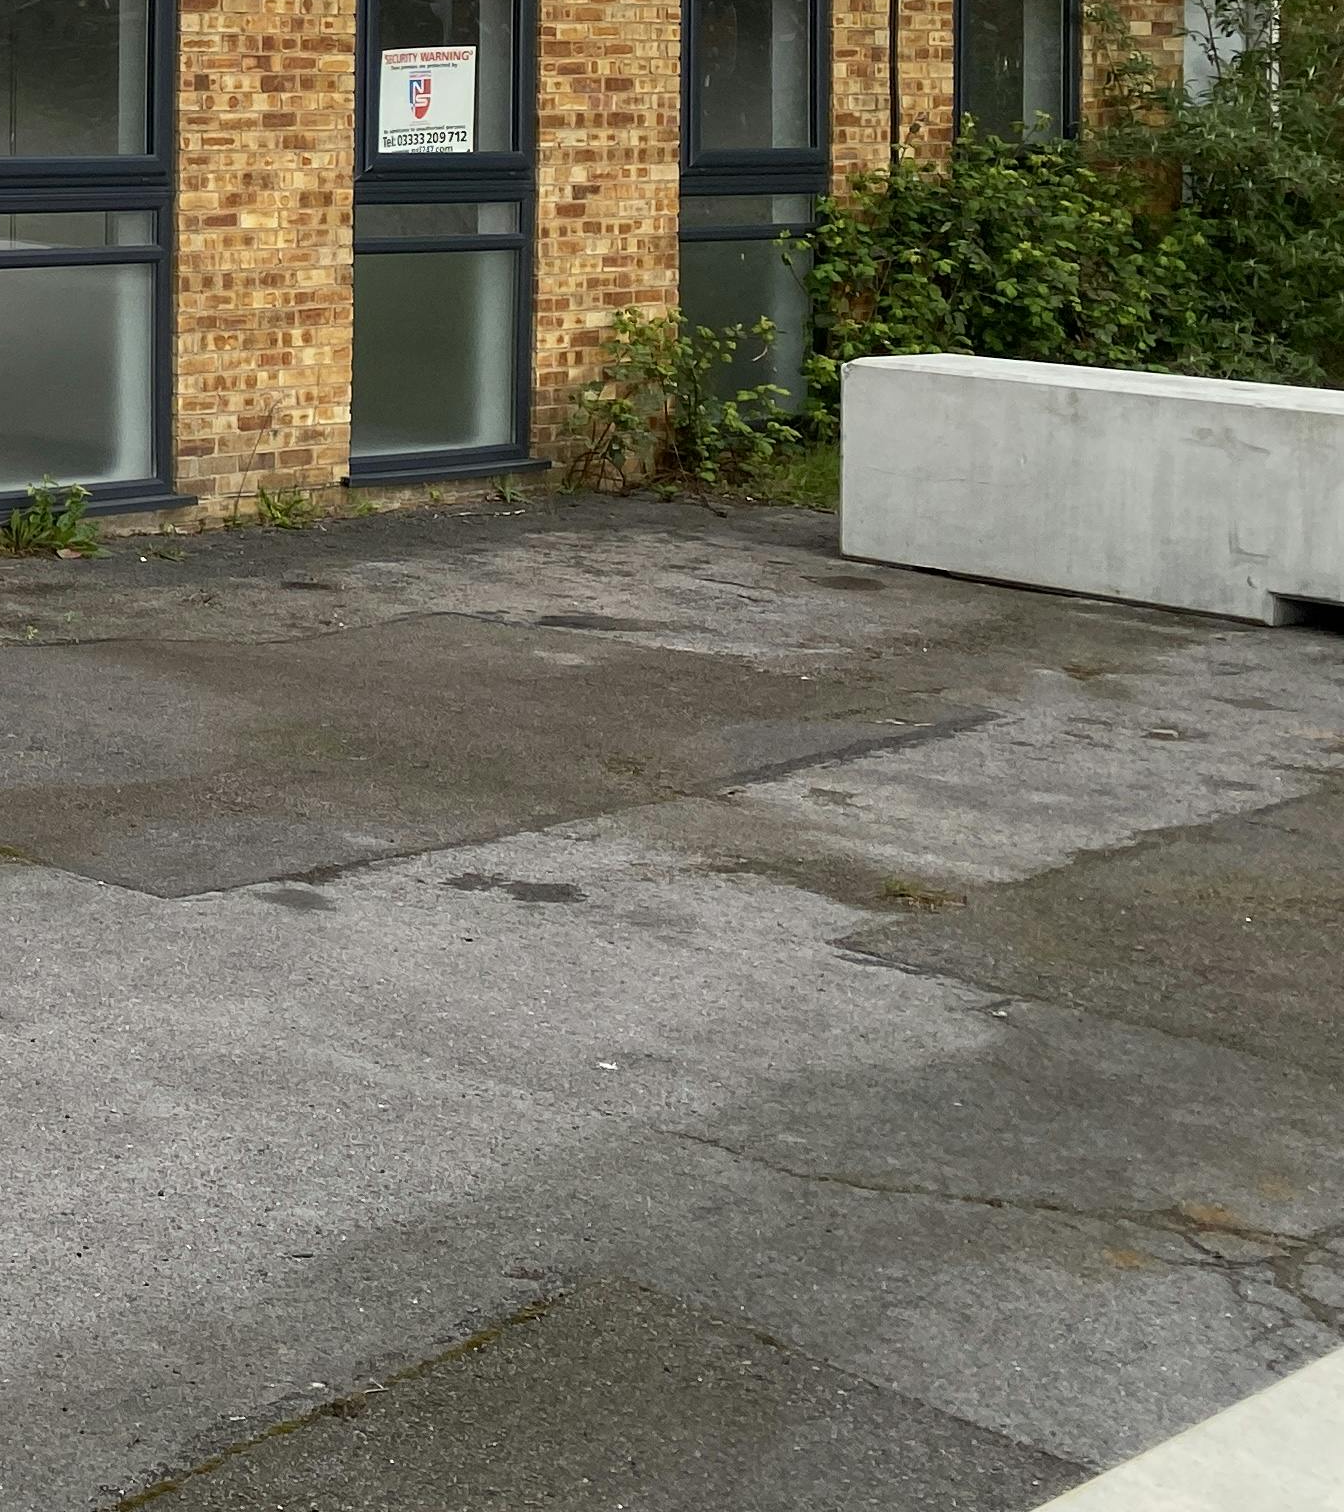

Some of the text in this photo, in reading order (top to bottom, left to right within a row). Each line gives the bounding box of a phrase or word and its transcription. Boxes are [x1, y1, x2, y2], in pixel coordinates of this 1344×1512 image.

[384, 51, 469, 64] SECURITY WARNING
[397, 133, 425, 146] 03333
[427, 132, 446, 144] 209
[448, 131, 467, 142] 712
